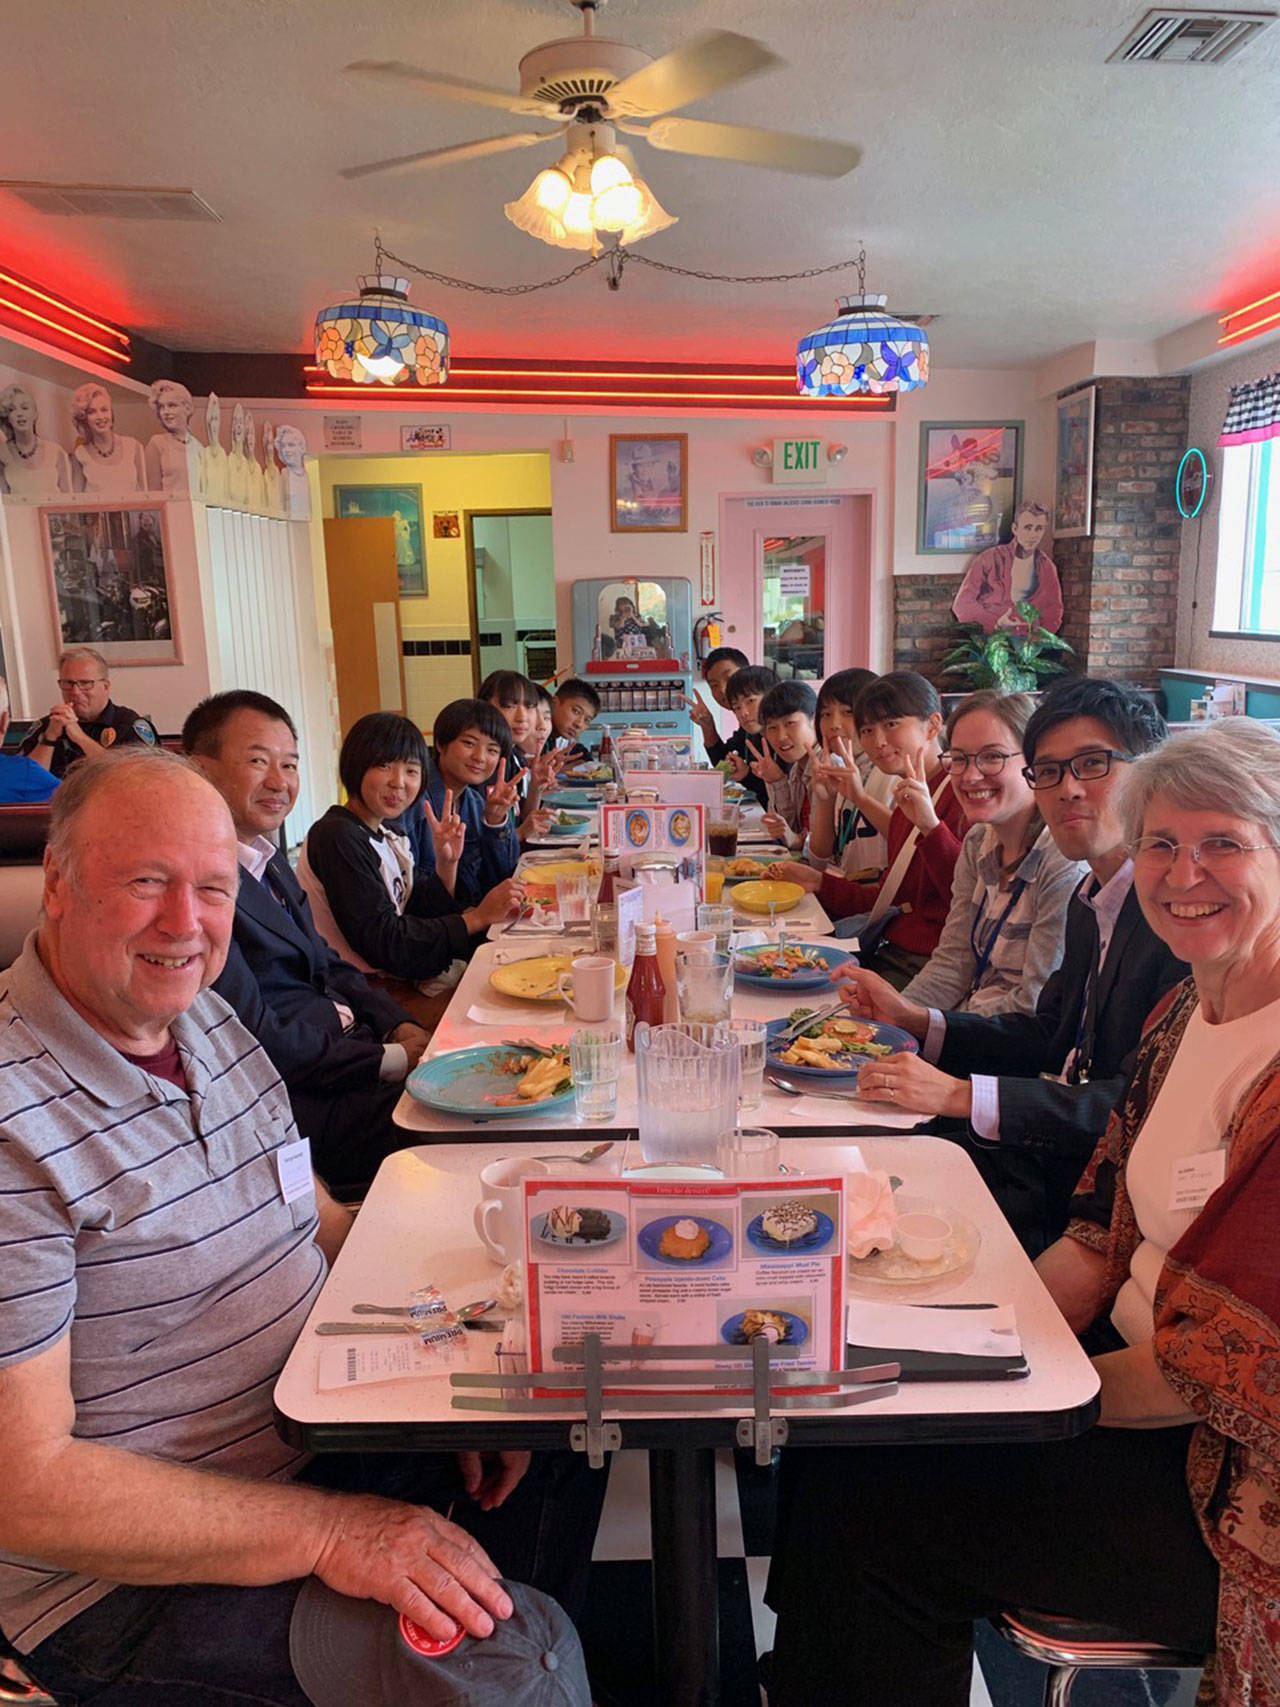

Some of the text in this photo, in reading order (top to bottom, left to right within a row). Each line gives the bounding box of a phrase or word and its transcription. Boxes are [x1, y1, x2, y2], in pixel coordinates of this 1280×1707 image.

[783, 441, 821, 470] EXIT
[409, 1305, 447, 1318] PREMIUM
[424, 1328, 463, 1345] PREMIUM
